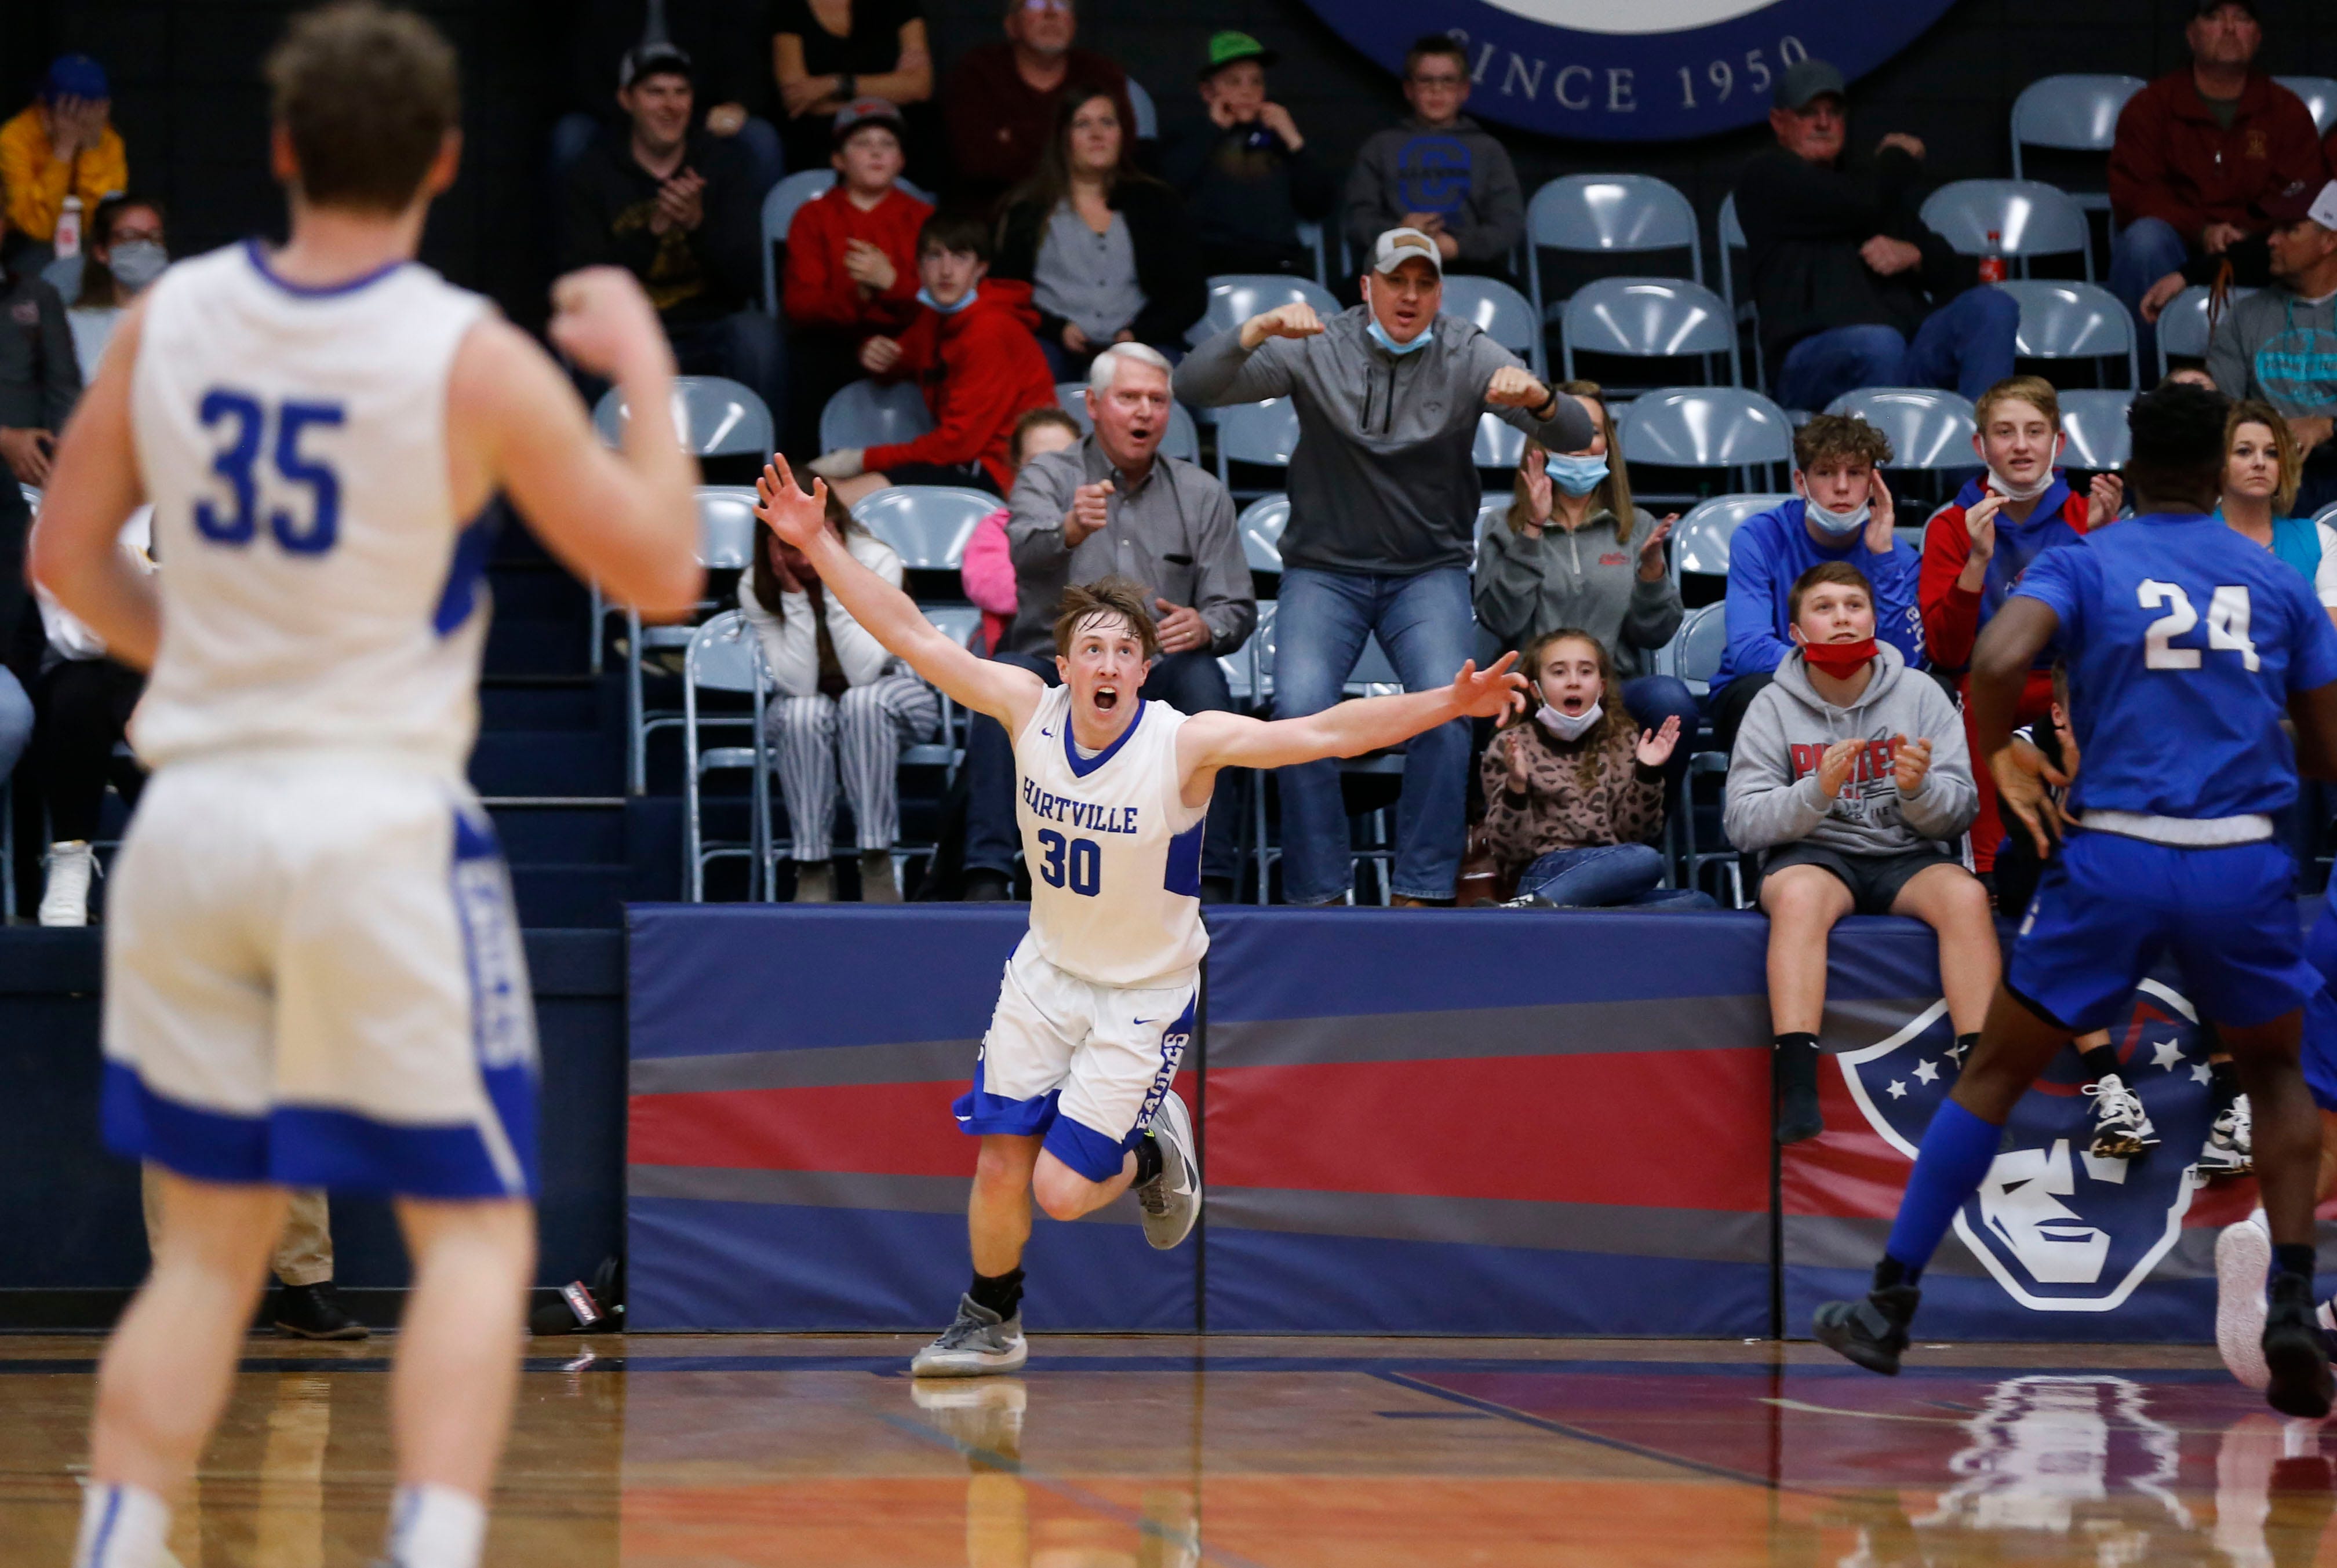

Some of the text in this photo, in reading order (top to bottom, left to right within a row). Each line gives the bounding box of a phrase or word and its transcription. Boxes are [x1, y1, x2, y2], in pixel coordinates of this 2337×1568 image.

[1677, 35, 1808, 108] 1950
[194, 388, 346, 556] 35
[2136, 578, 2260, 673] 24
[1024, 776, 1138, 834] HARTVILLE
[1038, 827, 1101, 897] 30
